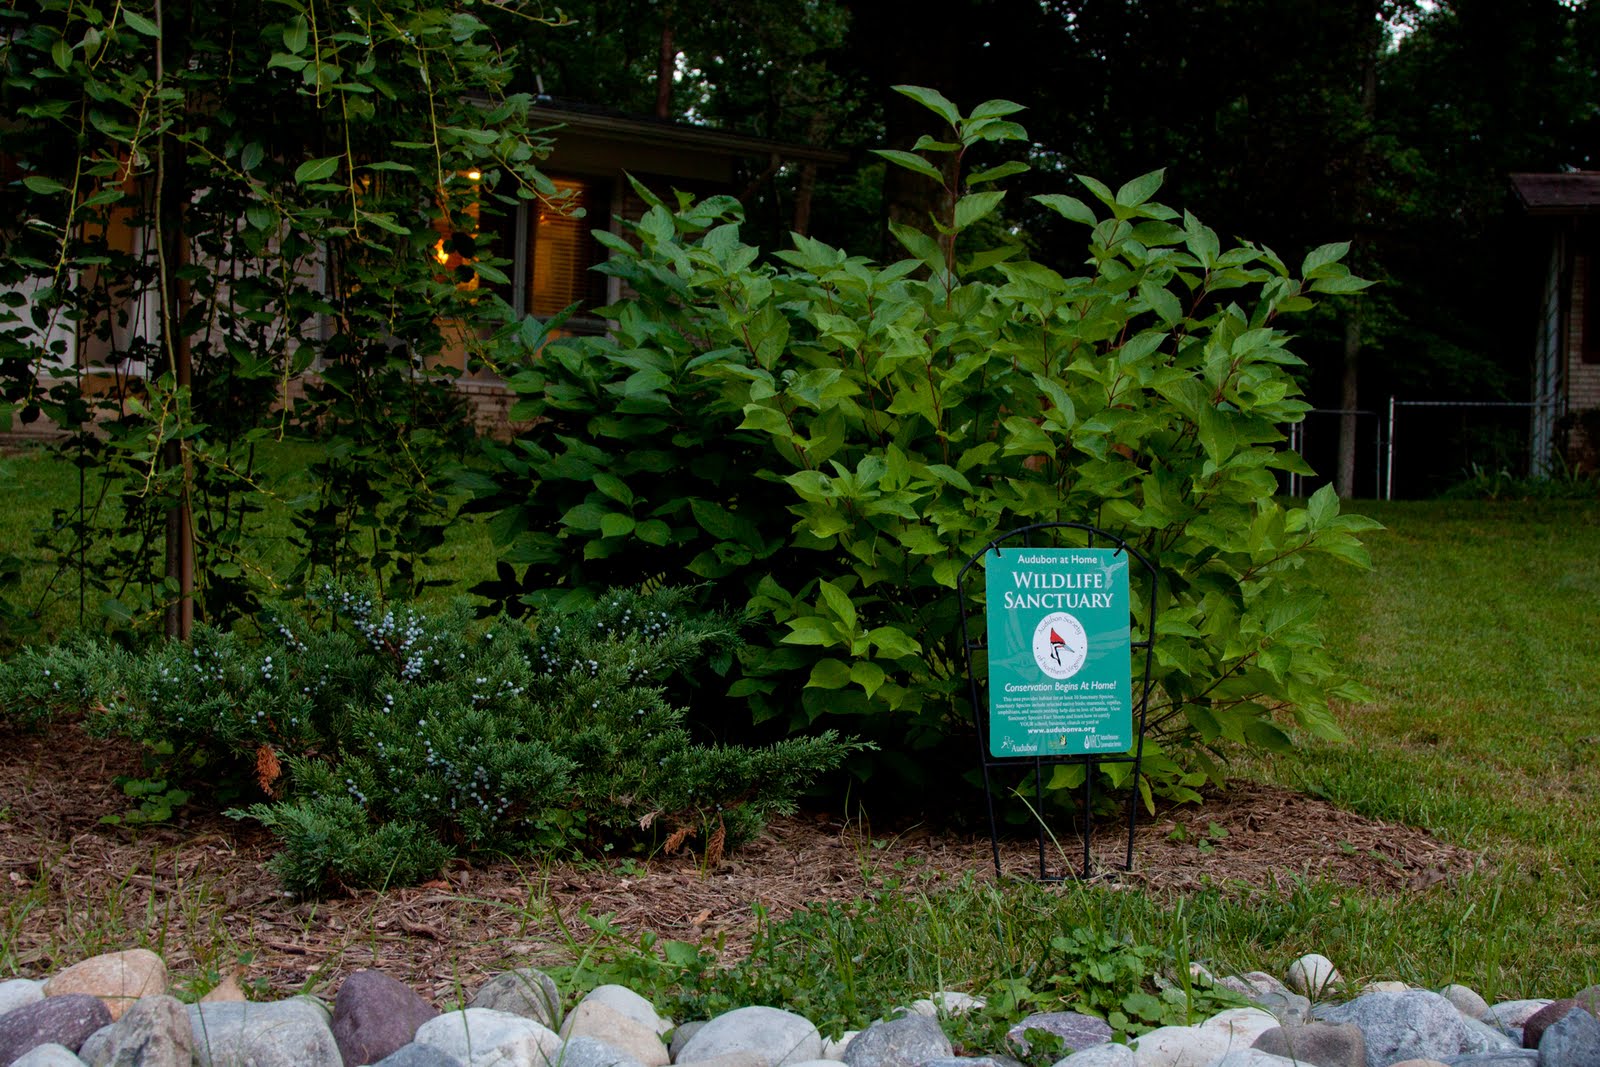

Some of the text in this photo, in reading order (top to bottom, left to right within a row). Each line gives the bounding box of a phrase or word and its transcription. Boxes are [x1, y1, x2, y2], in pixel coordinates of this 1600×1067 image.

[1018, 554, 1098, 564] Audubon at Home
[1012, 571, 1102, 589] WILDLIFE
[1004, 591, 1114, 609] SANCTUARY
[1038, 616, 1082, 636] Audubon Society
[1042, 661, 1066, 674] Northern
[1066, 654, 1083, 672] Virginia
[1004, 680, 1116, 693] Conservation Begins At Home!
[1011, 744, 1038, 752] Audubon
